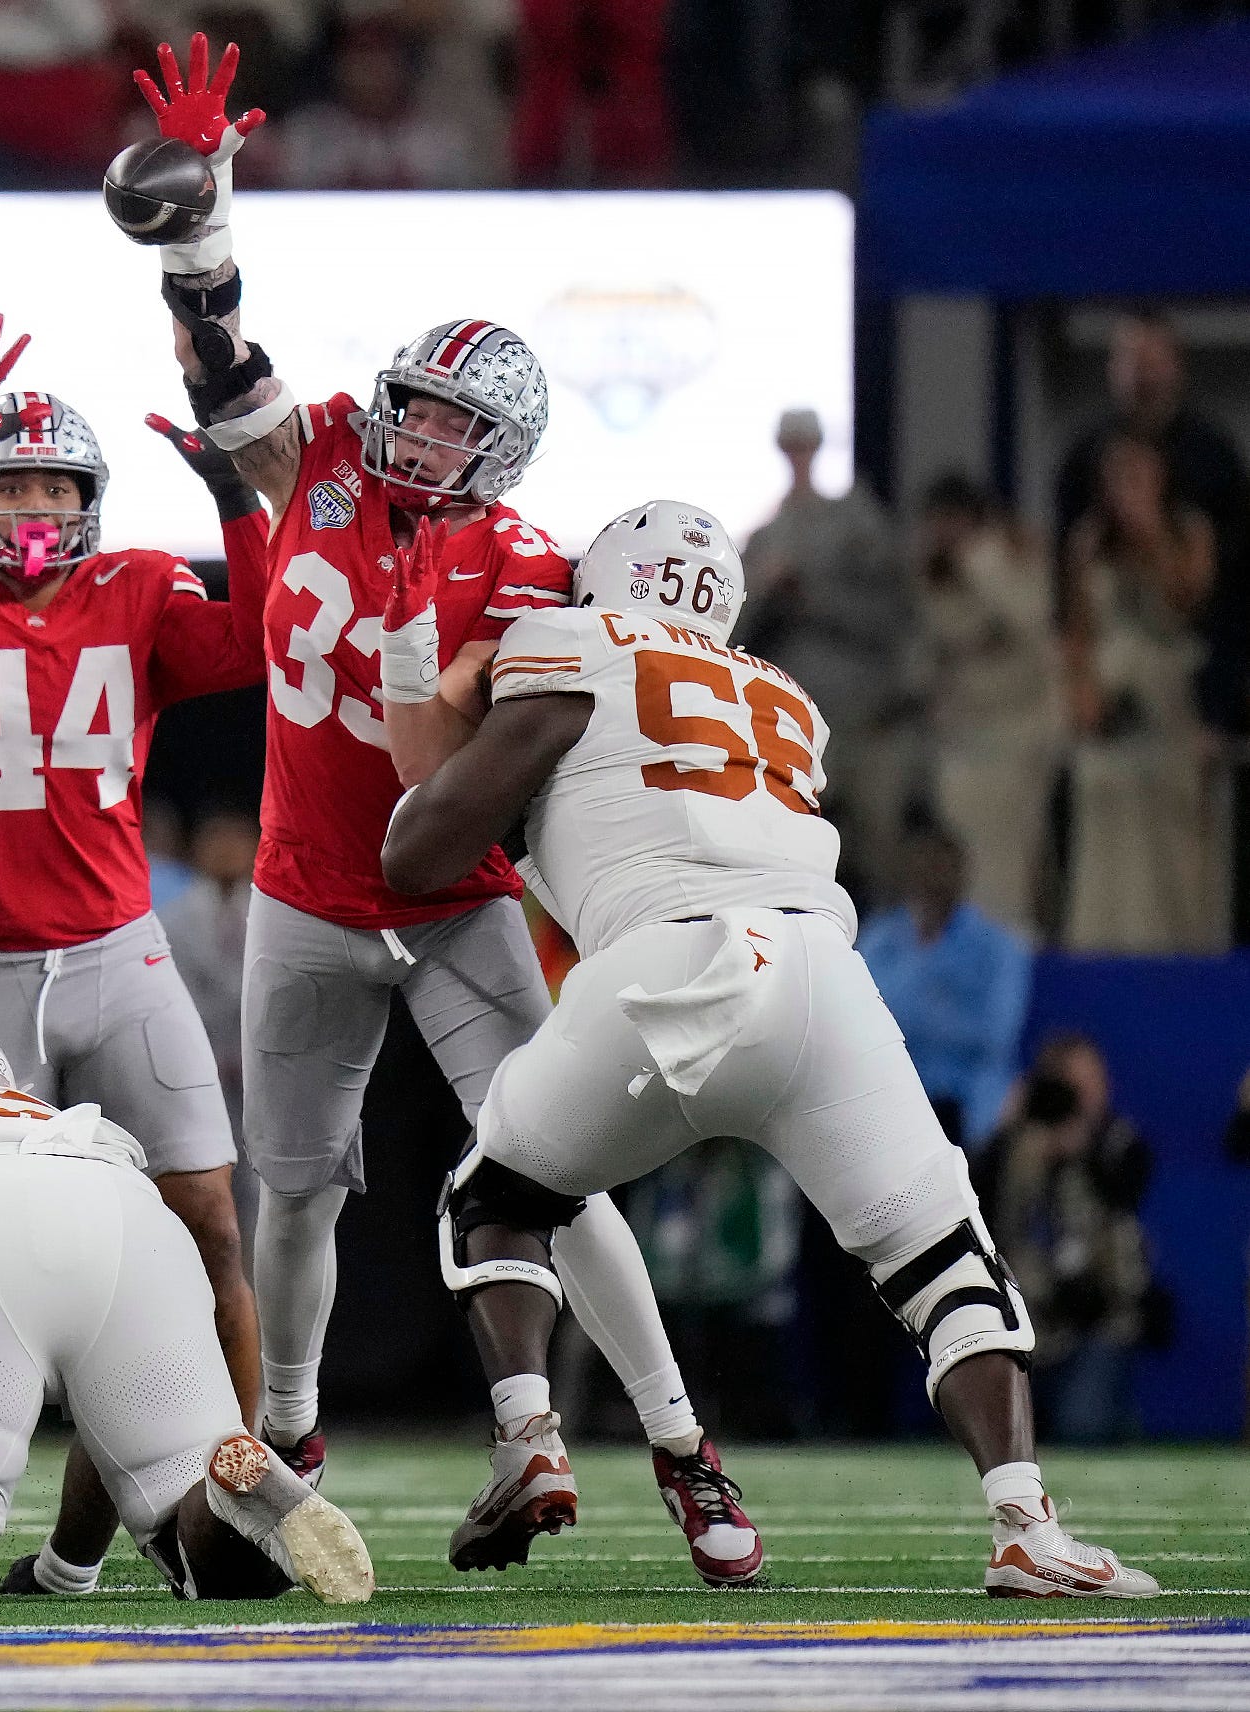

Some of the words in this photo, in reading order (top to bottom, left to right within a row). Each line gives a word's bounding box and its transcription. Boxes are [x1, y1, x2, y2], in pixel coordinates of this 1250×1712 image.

[313, 488, 350, 523] COTTON
[630, 579, 650, 600] SEC
[658, 556, 714, 614] 56
[600, 613, 651, 647] C.
[634, 649, 822, 817] 56
[936, 1337, 982, 1368] DONJOY
[1035, 1566, 1077, 1587] FORCE
